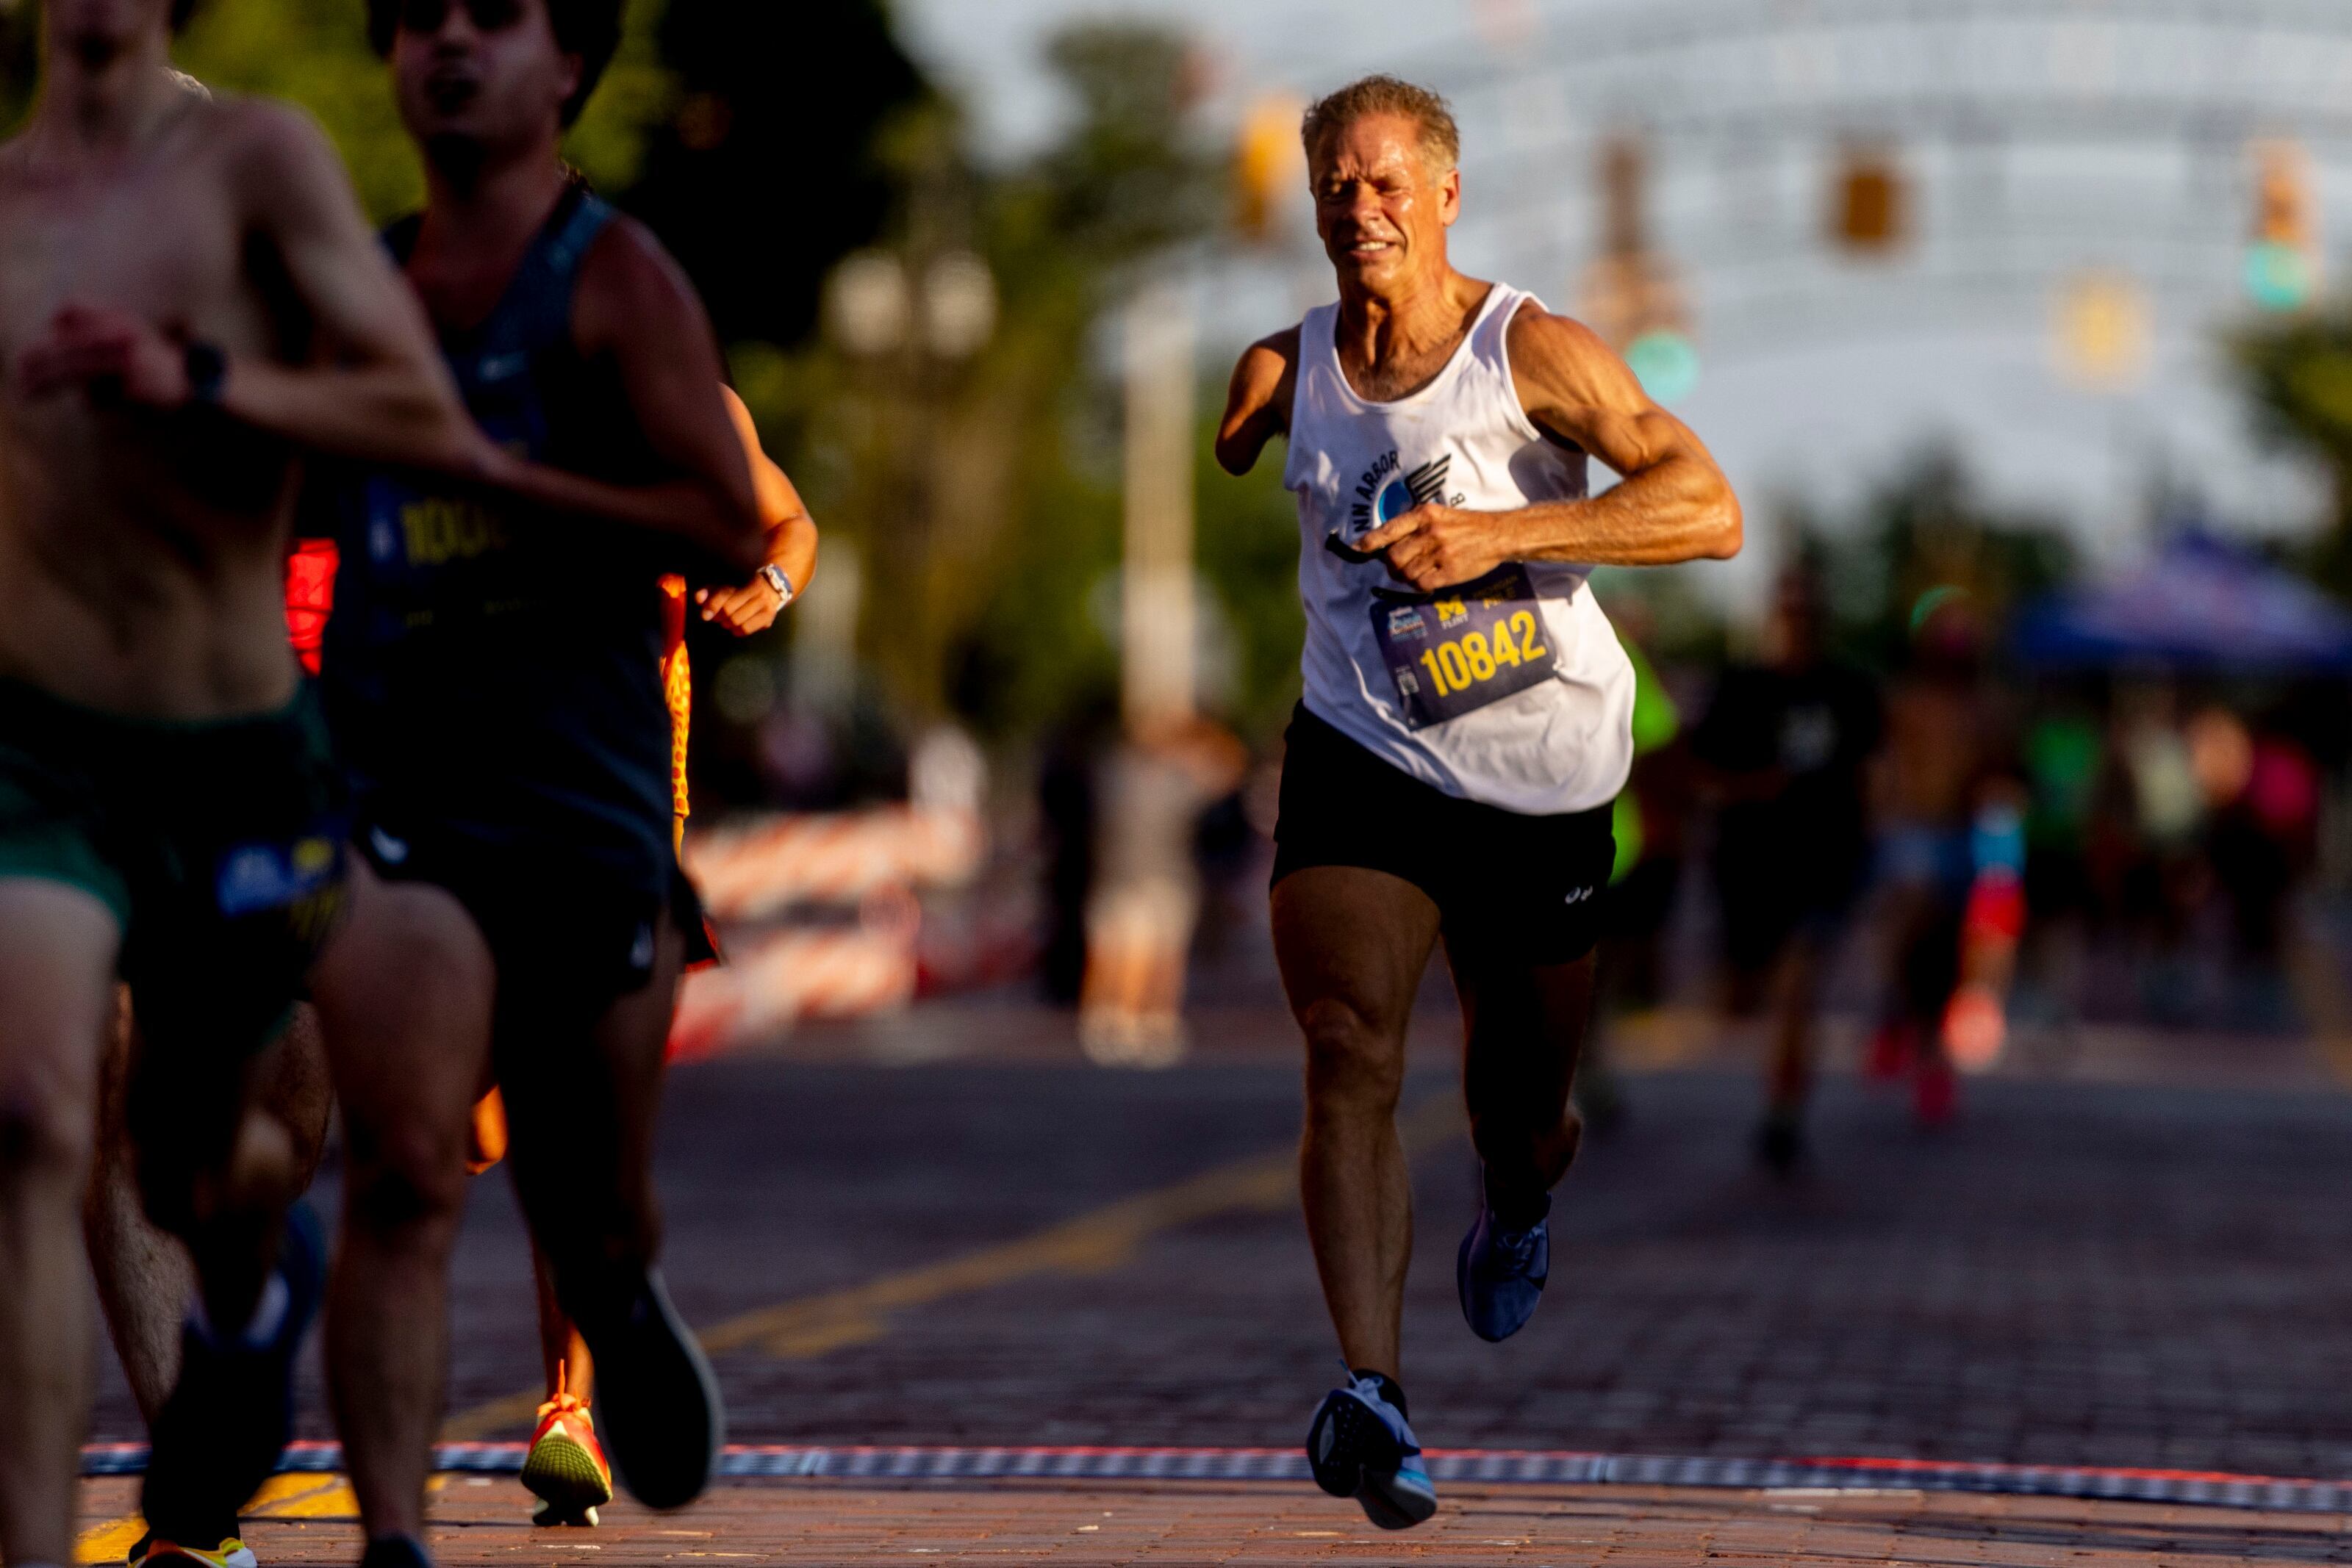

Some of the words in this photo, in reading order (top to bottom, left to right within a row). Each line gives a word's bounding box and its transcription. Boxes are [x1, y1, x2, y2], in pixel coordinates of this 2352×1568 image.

[1355, 450, 1401, 501] ARBOR
[1352, 503, 1371, 532] NN
[1419, 609, 1546, 697] 10842
